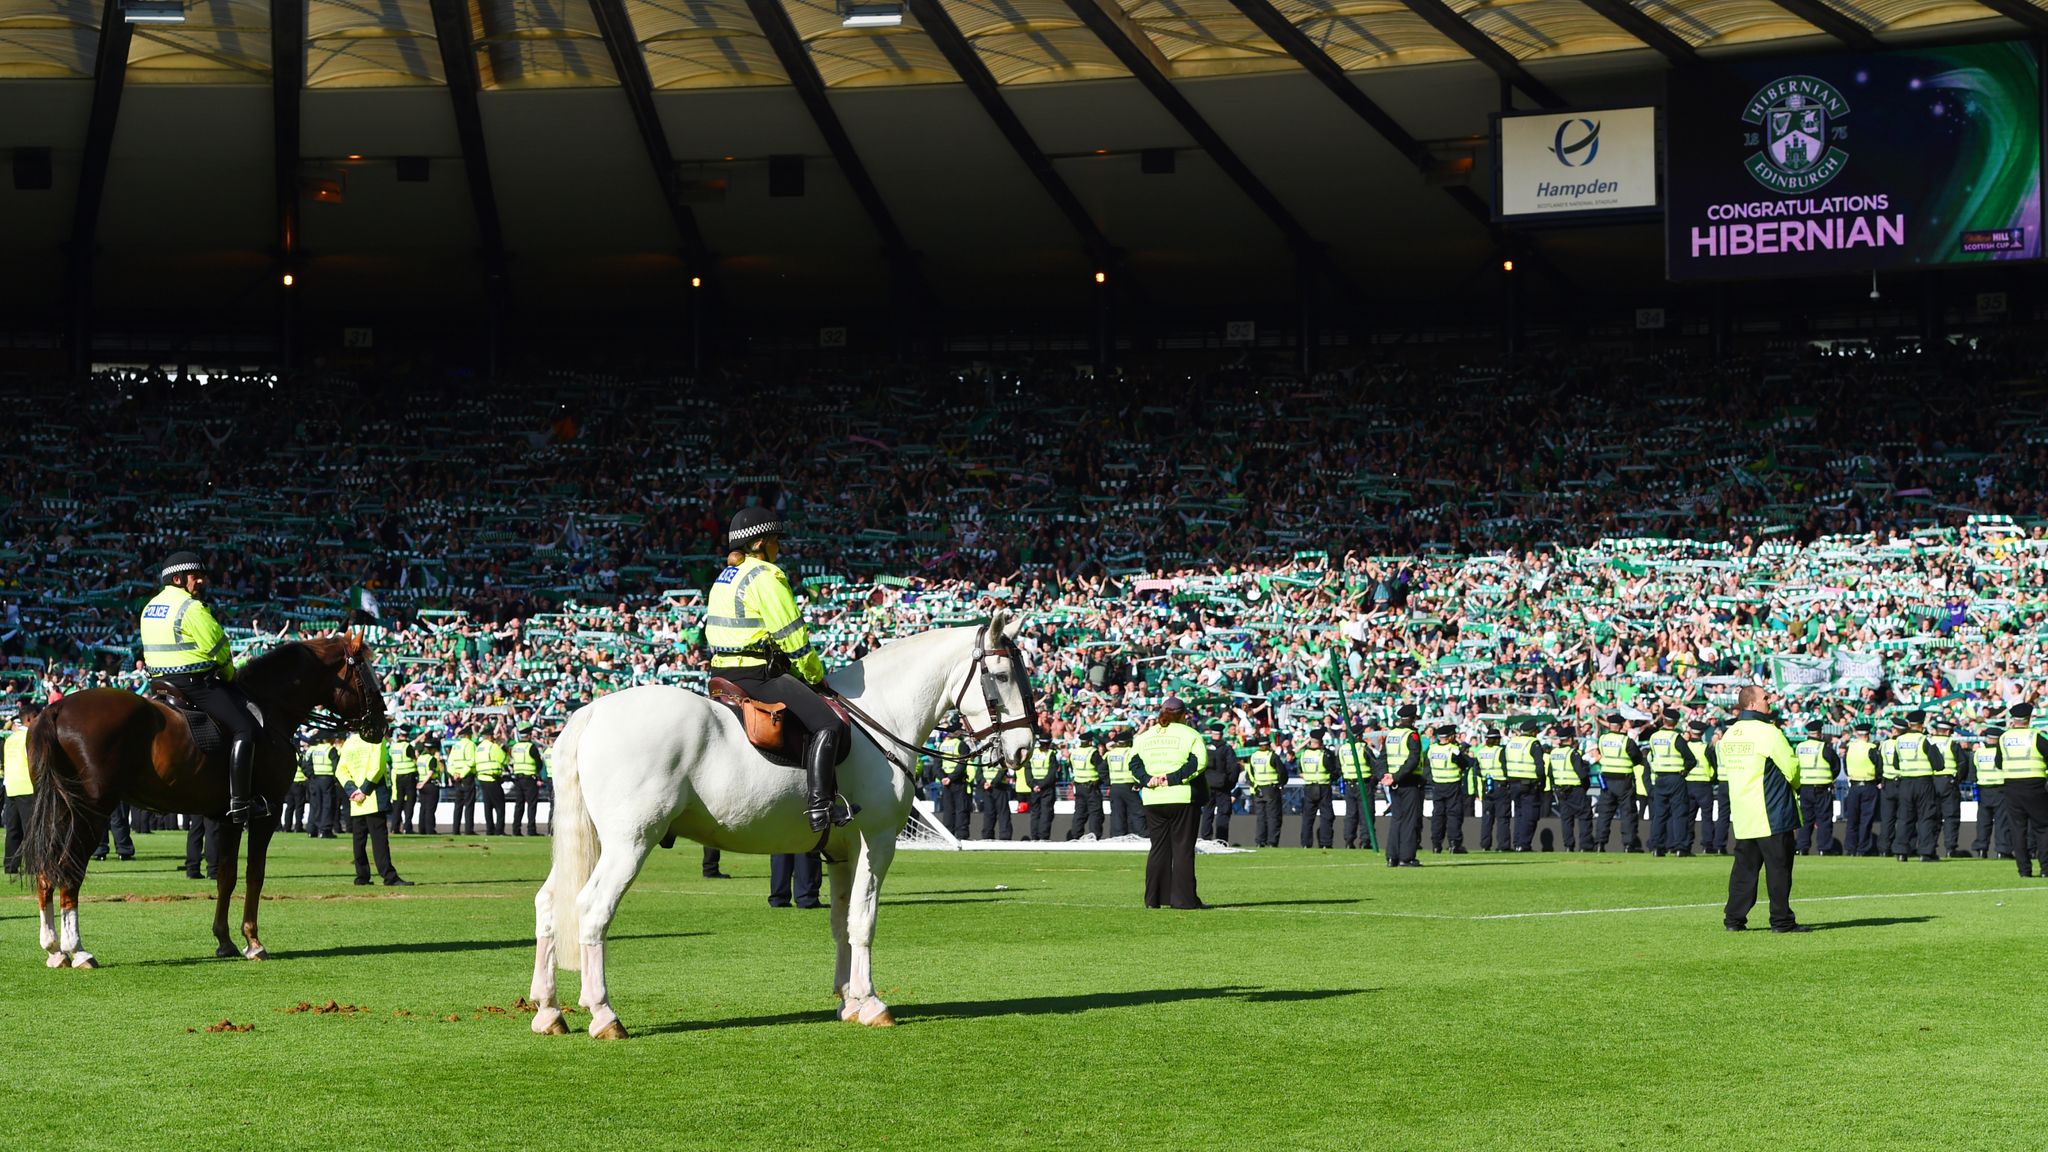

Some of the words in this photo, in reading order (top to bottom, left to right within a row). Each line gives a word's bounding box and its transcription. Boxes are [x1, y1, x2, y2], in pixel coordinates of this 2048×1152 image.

[1750, 80, 1841, 117] HIBERNIAN
[1754, 157, 1839, 189] EDINBURGH
[1536, 179, 1618, 199] Hampden
[1706, 193, 1889, 220] CONGRATULATIONS
[1691, 213, 1905, 258] HIBERNIAN
[1992, 232, 2010, 242] HILL
[1963, 243, 1995, 251] SCOTTISH
[1980, 295, 2002, 310] 35
[348, 330, 369, 344] 31
[823, 330, 843, 344] 32
[145, 605, 169, 618] POLICE
